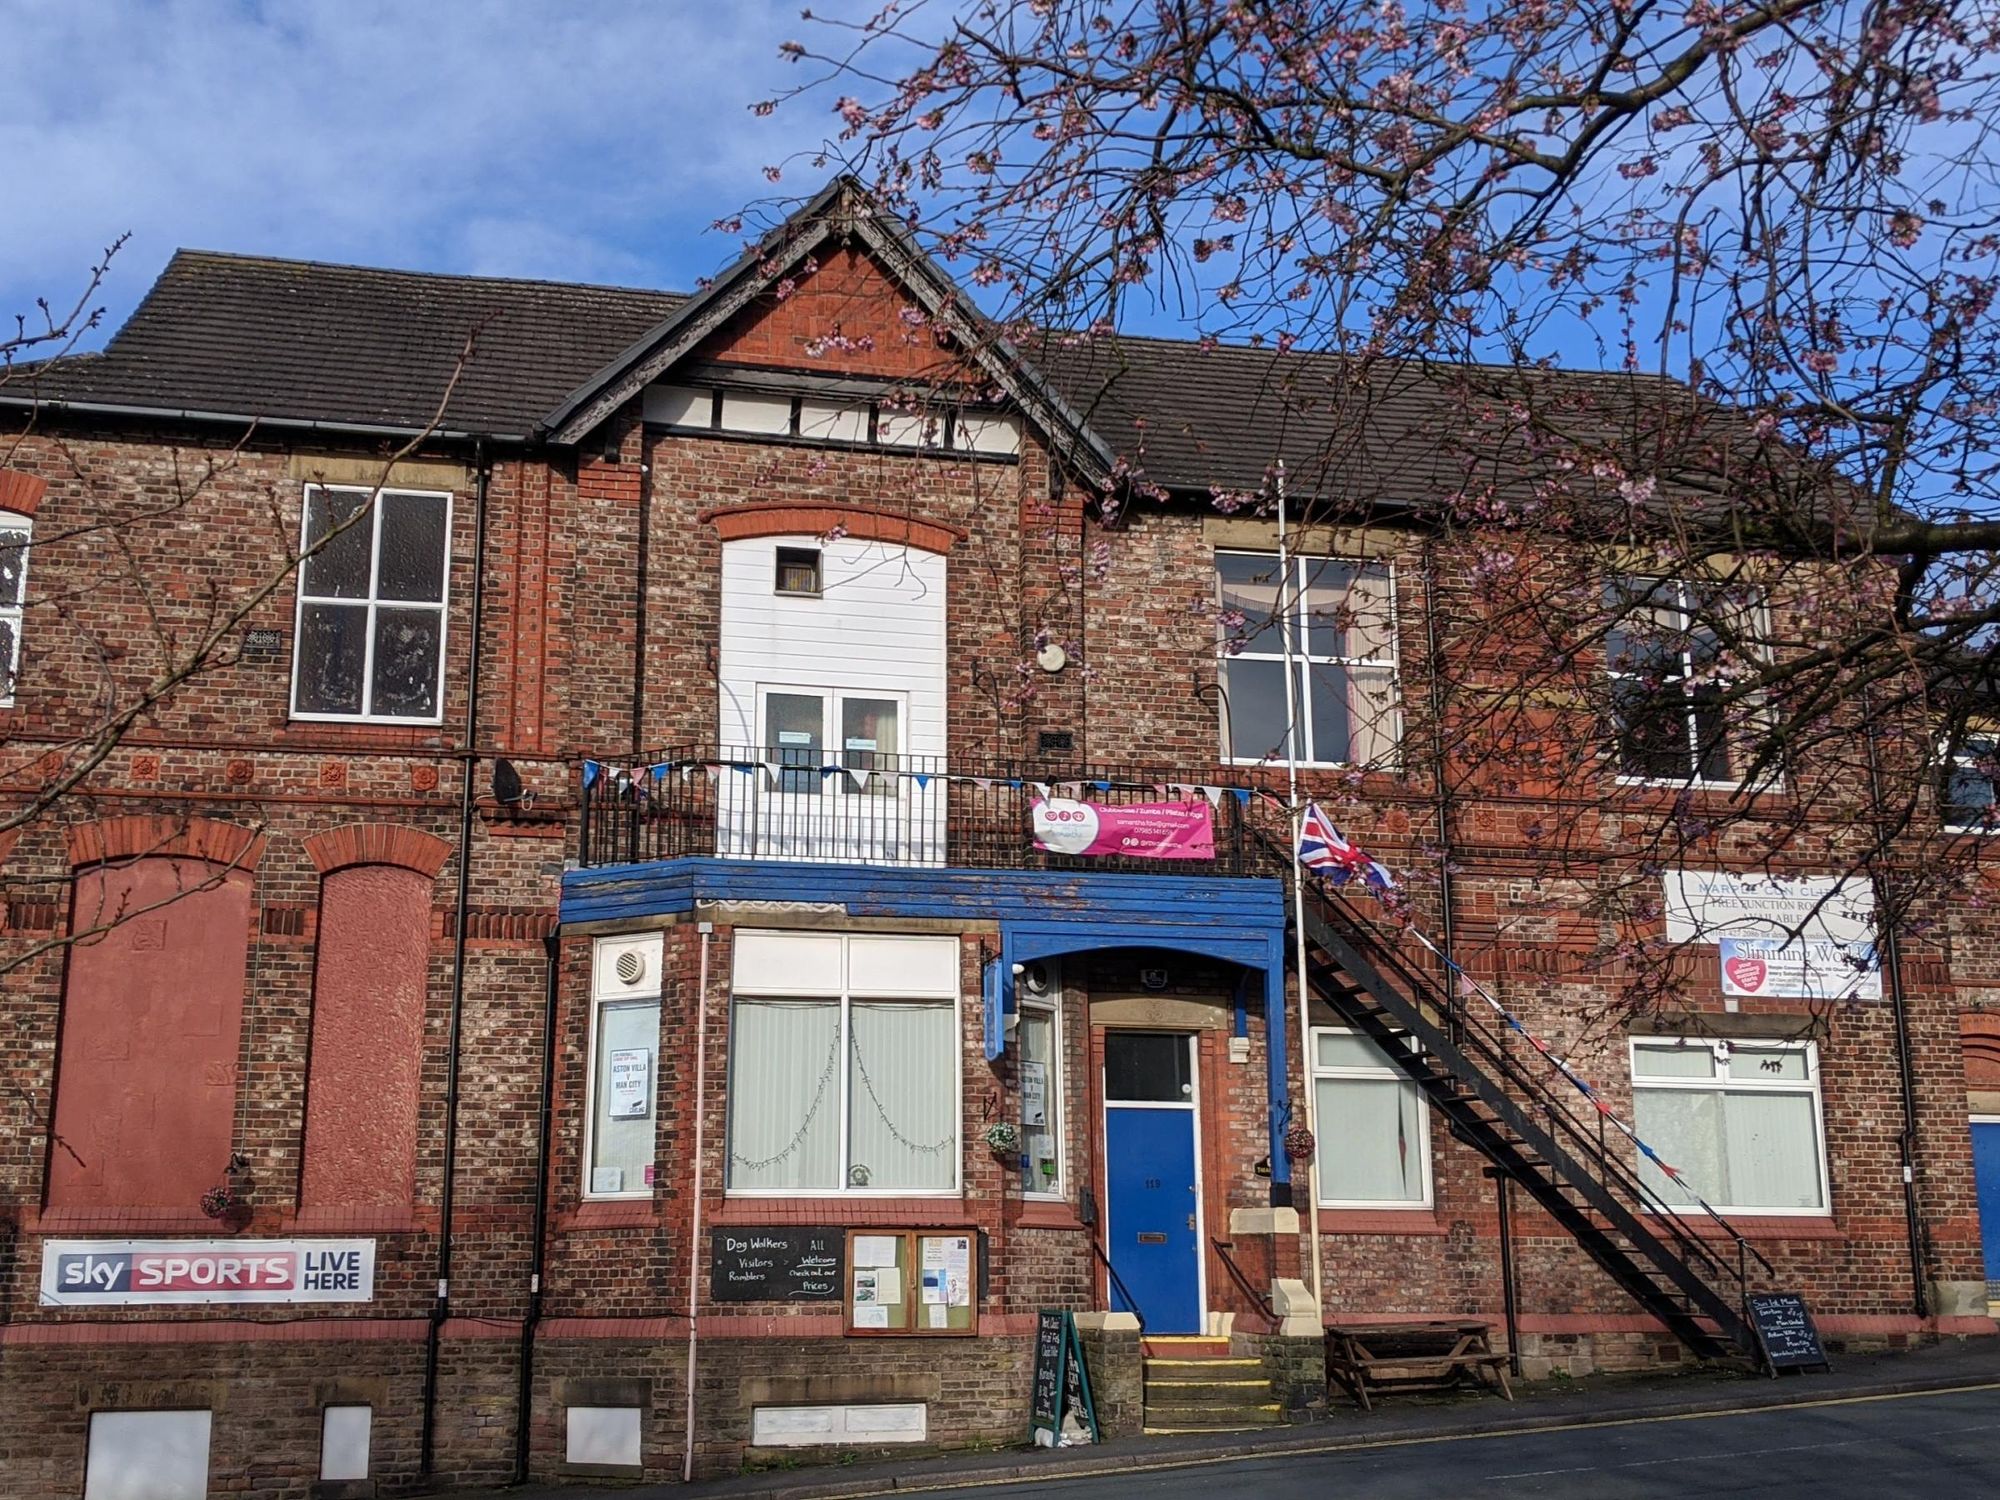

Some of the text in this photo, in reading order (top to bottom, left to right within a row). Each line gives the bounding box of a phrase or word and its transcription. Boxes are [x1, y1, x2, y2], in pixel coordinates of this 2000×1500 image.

[1741, 900, 1796, 911] FUNCTION
[1735, 941, 1861, 964] Slimming World
[613, 1063, 646, 1072] ASTON VILLA
[626, 1072, 631, 1080] V
[616, 1080, 641, 1089] MAN CITY
[726, 1237, 825, 1253] Dog Walkers All
[304, 1251, 361, 1272] LIVE
[739, 1256, 837, 1269] Visitors Welcome
[64, 1255, 290, 1291] sky SPORTS
[728, 1271, 766, 1282] Ramblers
[789, 1270, 811, 1278] Check
[303, 1271, 360, 1291] HERE
[803, 1281, 828, 1290] Prices
[1753, 1299, 1768, 1308] Sun
